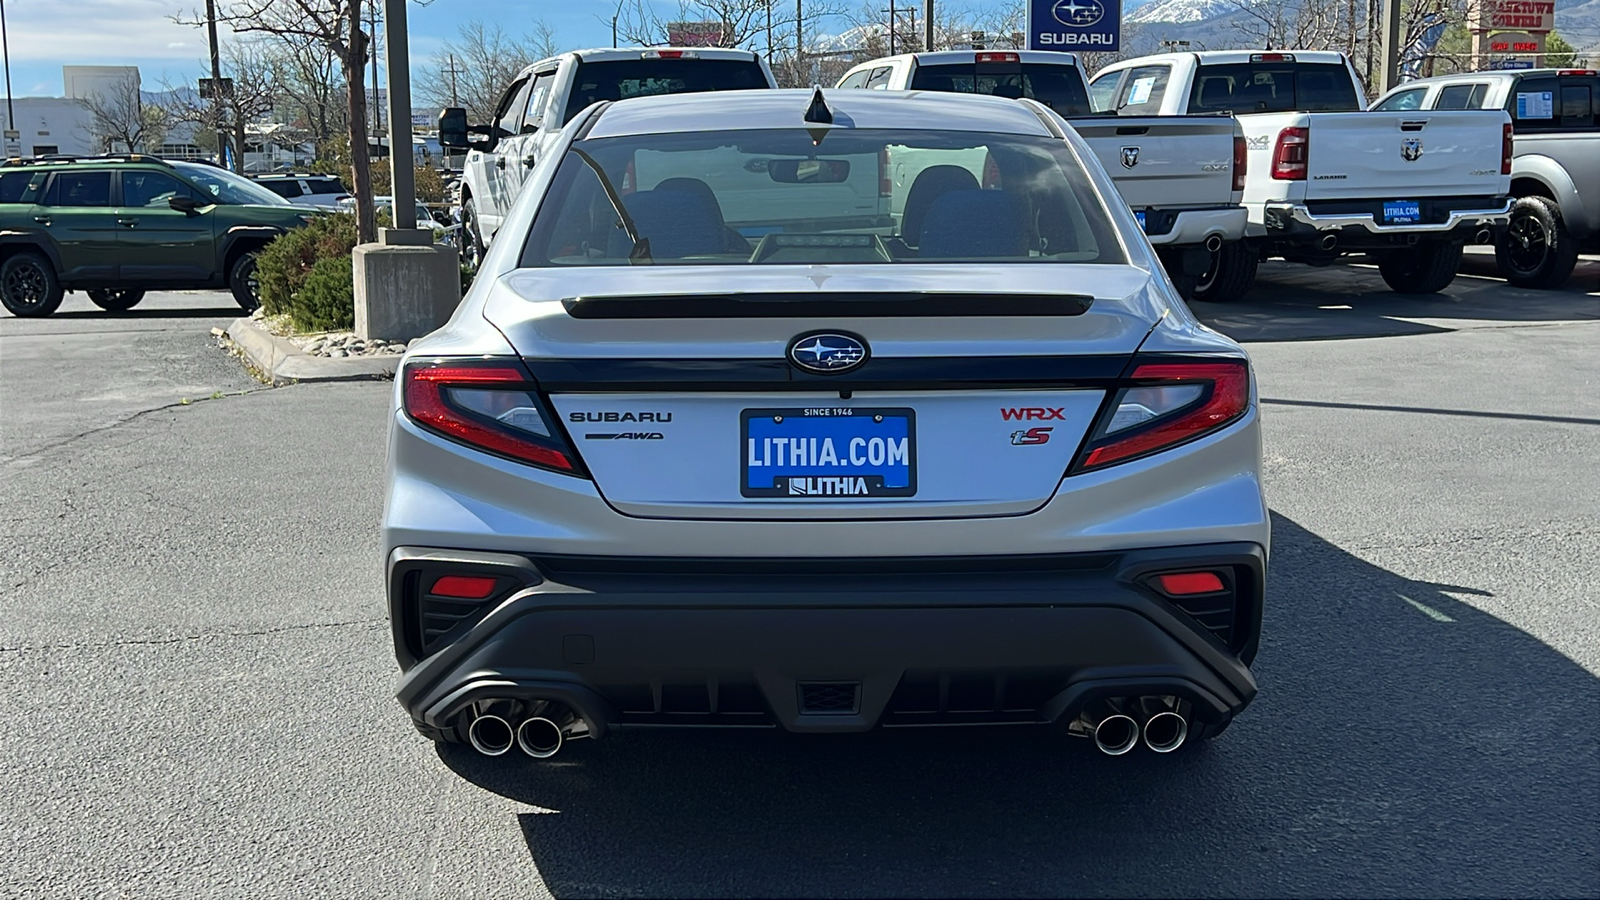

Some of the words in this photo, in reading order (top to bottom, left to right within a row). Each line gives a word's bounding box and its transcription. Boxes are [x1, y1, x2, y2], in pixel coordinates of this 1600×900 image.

[1040, 33, 1113, 44] SUBARU
[1491, 42, 1509, 50] CAR
[1513, 42, 1538, 50] WASH
[1384, 207, 1420, 216] LITHIA.COM
[569, 412, 672, 422] SUBARU
[804, 408, 830, 416] SINCE
[833, 408, 852, 416] 1946
[1001, 407, 1066, 421] WRX
[614, 432, 664, 440] AWD
[1010, 427, 1054, 445] tS
[748, 437, 909, 467] LITHIA.COM
[807, 477, 869, 495] LITHIA
